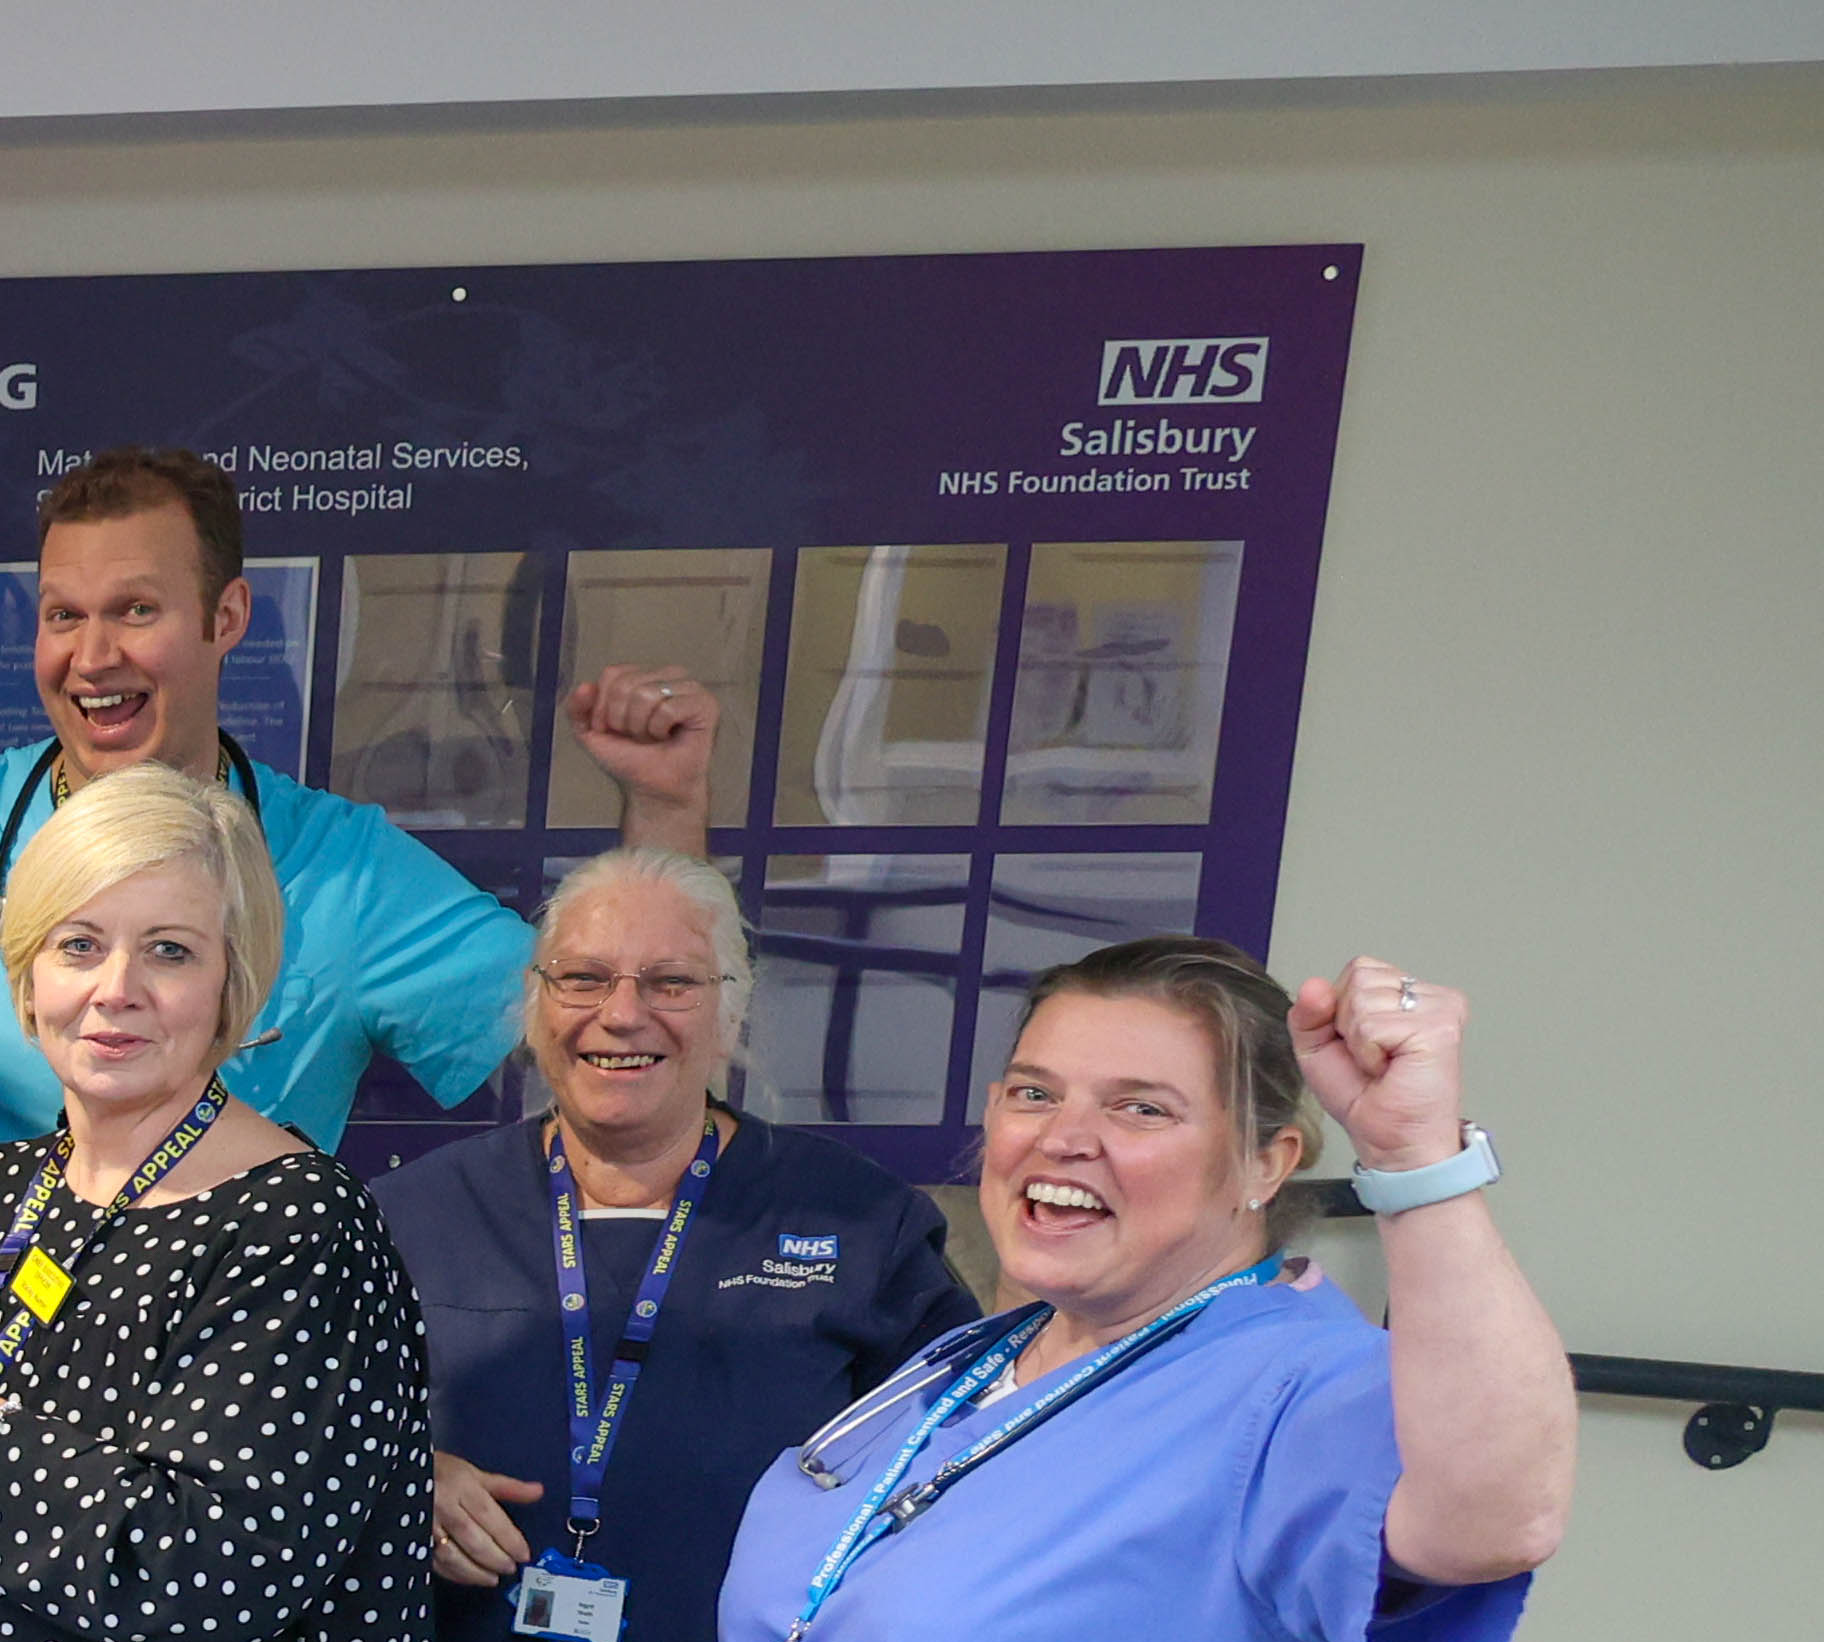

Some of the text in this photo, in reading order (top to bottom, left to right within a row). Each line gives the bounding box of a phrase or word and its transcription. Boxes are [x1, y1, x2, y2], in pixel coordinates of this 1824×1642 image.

[1102, 342, 1262, 400] NHS
[248, 442, 382, 472] Neonatal
[391, 441, 530, 472] Services,
[1059, 418, 1257, 463] Salisbury
[292, 482, 413, 517] Hospital
[938, 467, 1252, 495] NHS Foundation Trust
[132, 1123, 203, 1194] APPEAL
[13, 1157, 63, 1234] APPEAL
[558, 1192, 577, 1269] STARS APPEAL
[651, 1199, 692, 1275] STARS APPEAL
[782, 1238, 835, 1257] NHS
[718, 1275, 745, 1290] NHS
[745, 1274, 807, 1289] Foundation
[761, 1258, 837, 1276] Salisbury
[571, 1336, 589, 1418] STARS APPEAL
[586, 1382, 625, 1465] STARS APPEAL
[811, 1503, 877, 1589] Professional
[874, 1446, 914, 1495] Patient
[907, 1397, 956, 1447] Centred
[952, 1377, 979, 1400] and
[972, 1352, 1006, 1380] Safe
